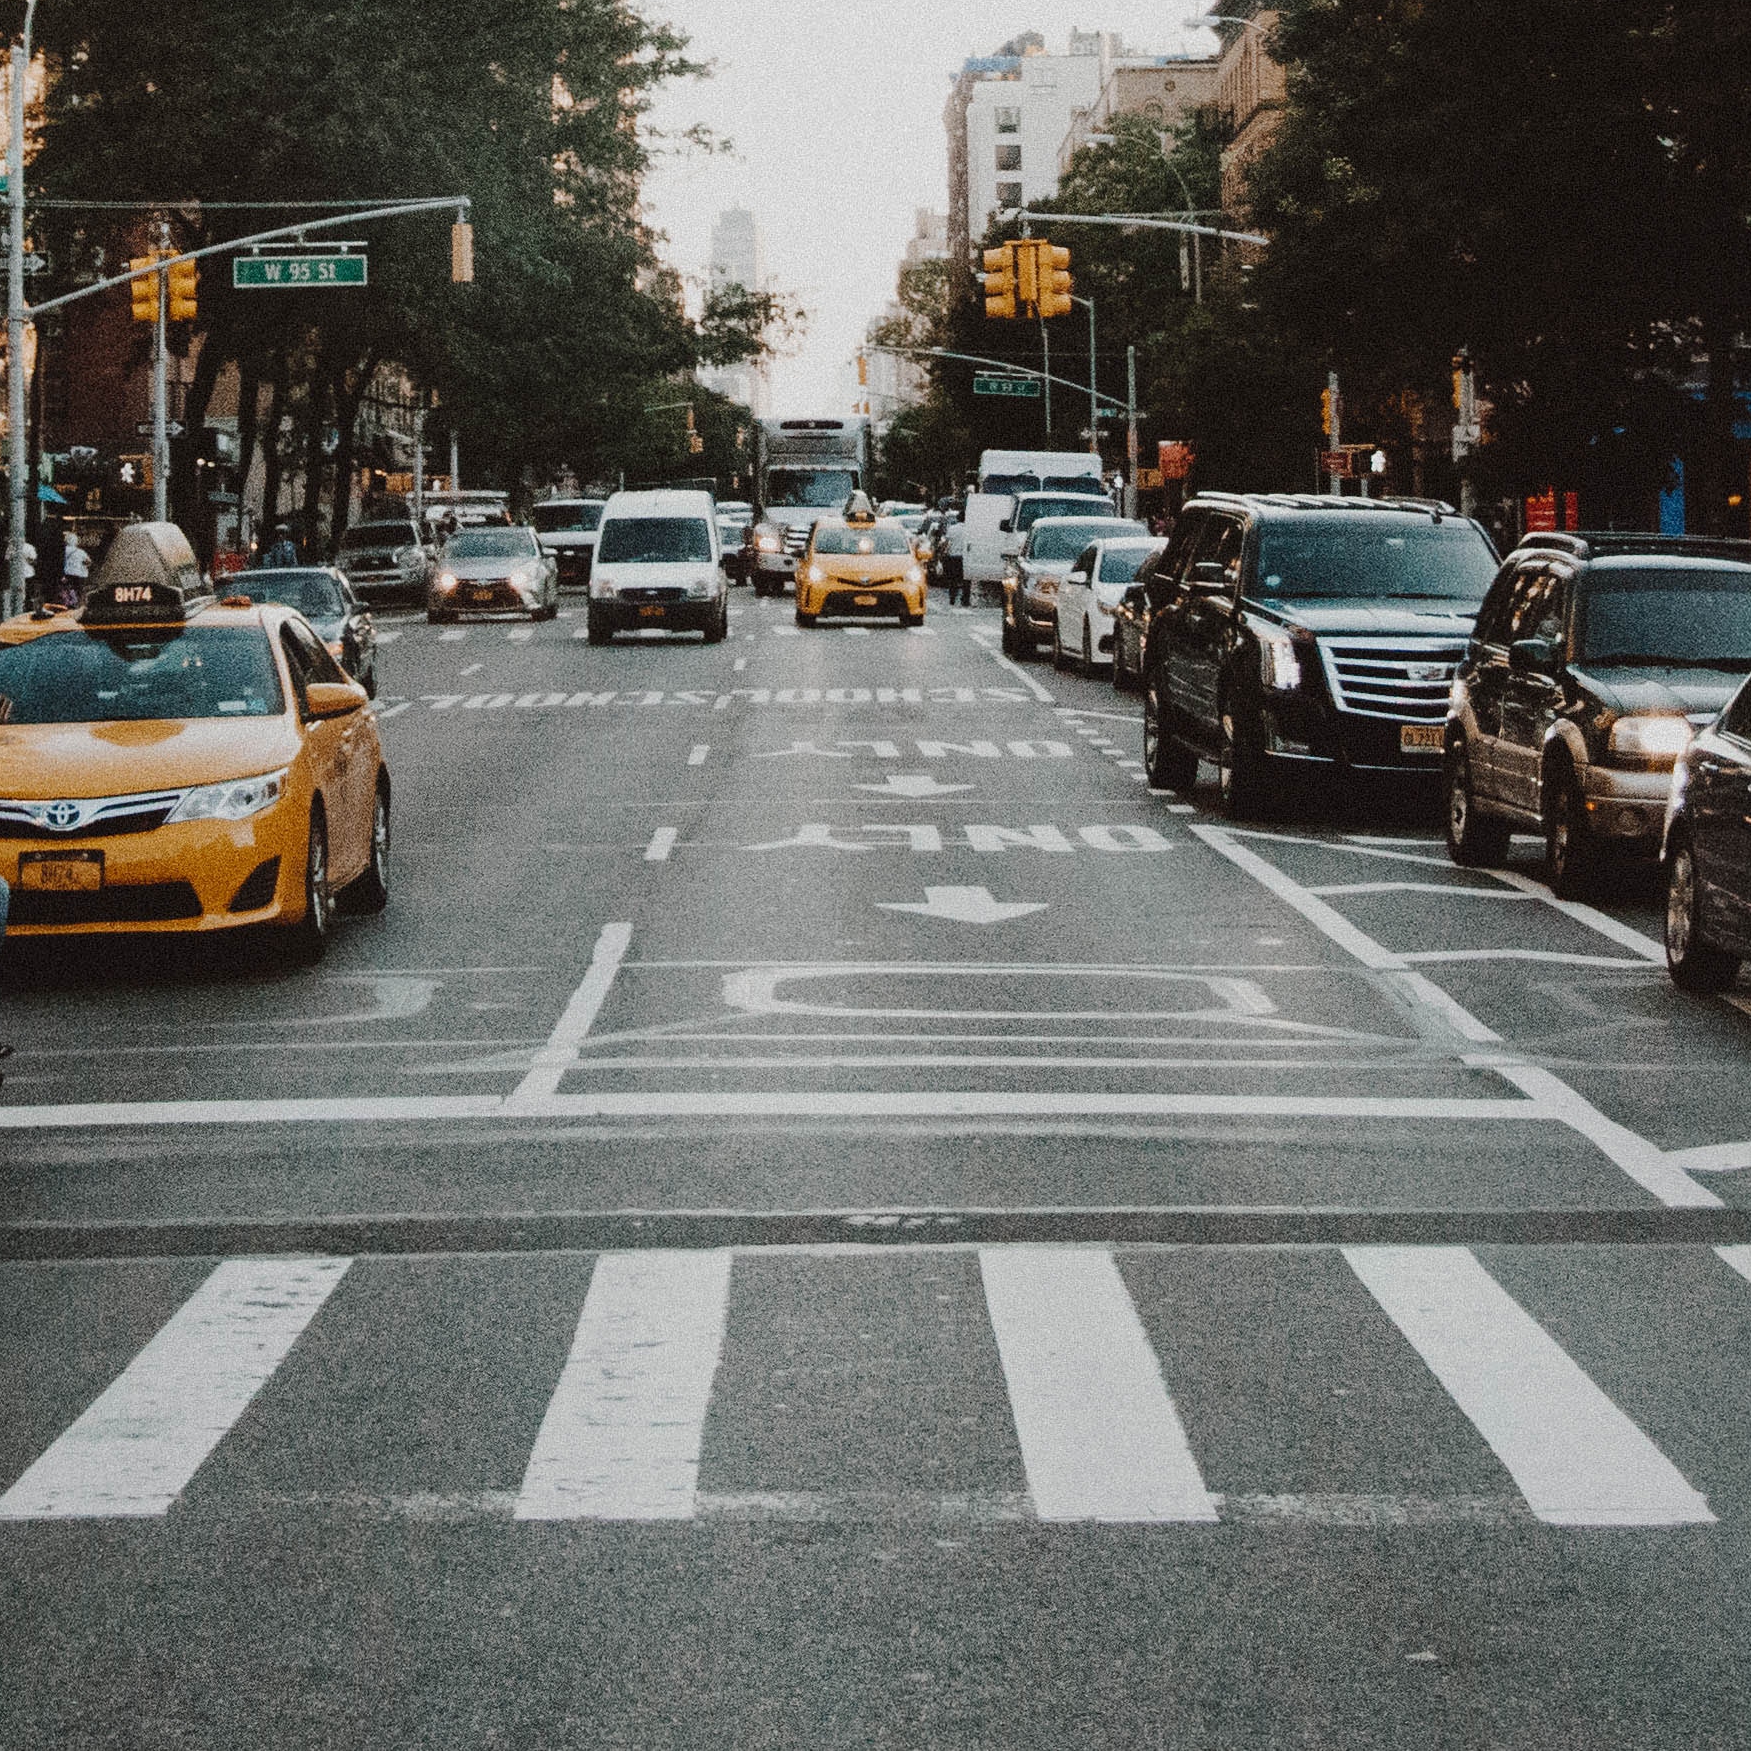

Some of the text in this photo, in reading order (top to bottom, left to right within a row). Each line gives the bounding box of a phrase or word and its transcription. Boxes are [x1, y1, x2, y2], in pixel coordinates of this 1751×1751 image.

[264, 262, 336, 280] W 95 St
[115, 586, 152, 603] 8H74
[750, 740, 1074, 758] ONLY
[742, 823, 1176, 853] ONLY
